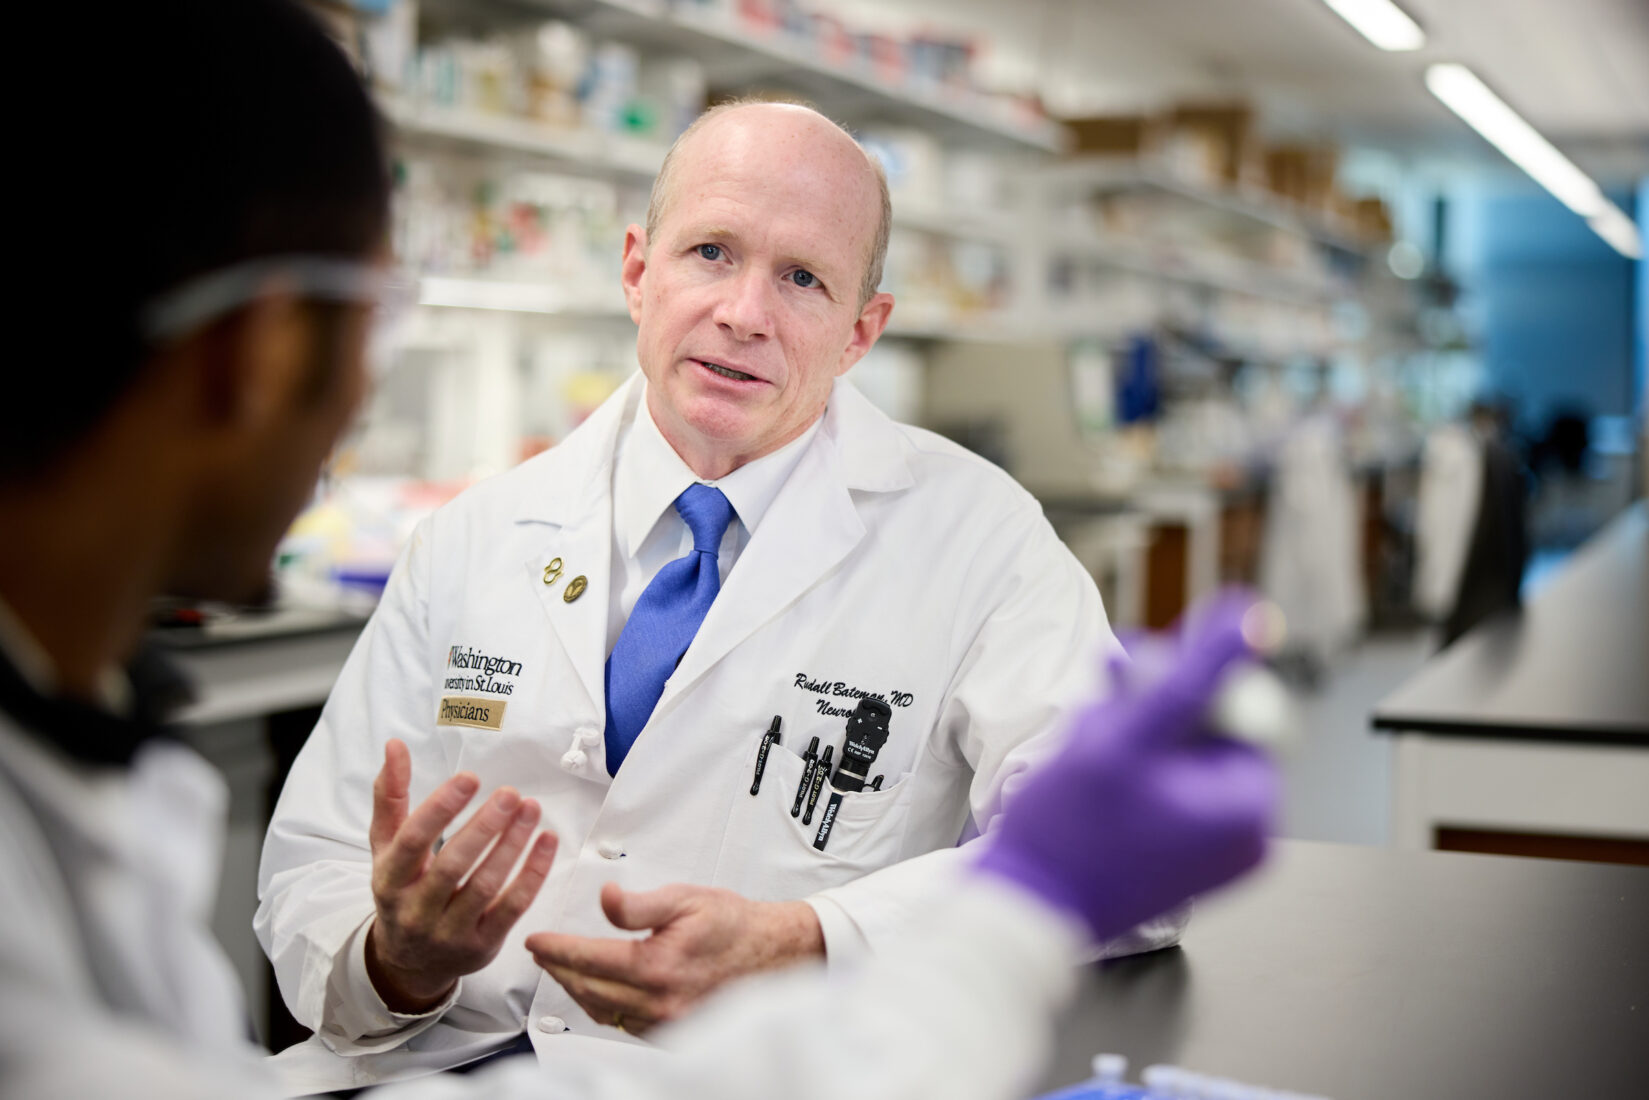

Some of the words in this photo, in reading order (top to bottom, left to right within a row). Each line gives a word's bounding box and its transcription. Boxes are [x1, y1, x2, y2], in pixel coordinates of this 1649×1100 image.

[448, 645, 522, 677] Washington
[486, 676, 514, 696] Louis
[890, 690, 914, 707] MD
[441, 699, 490, 722] Physicians
